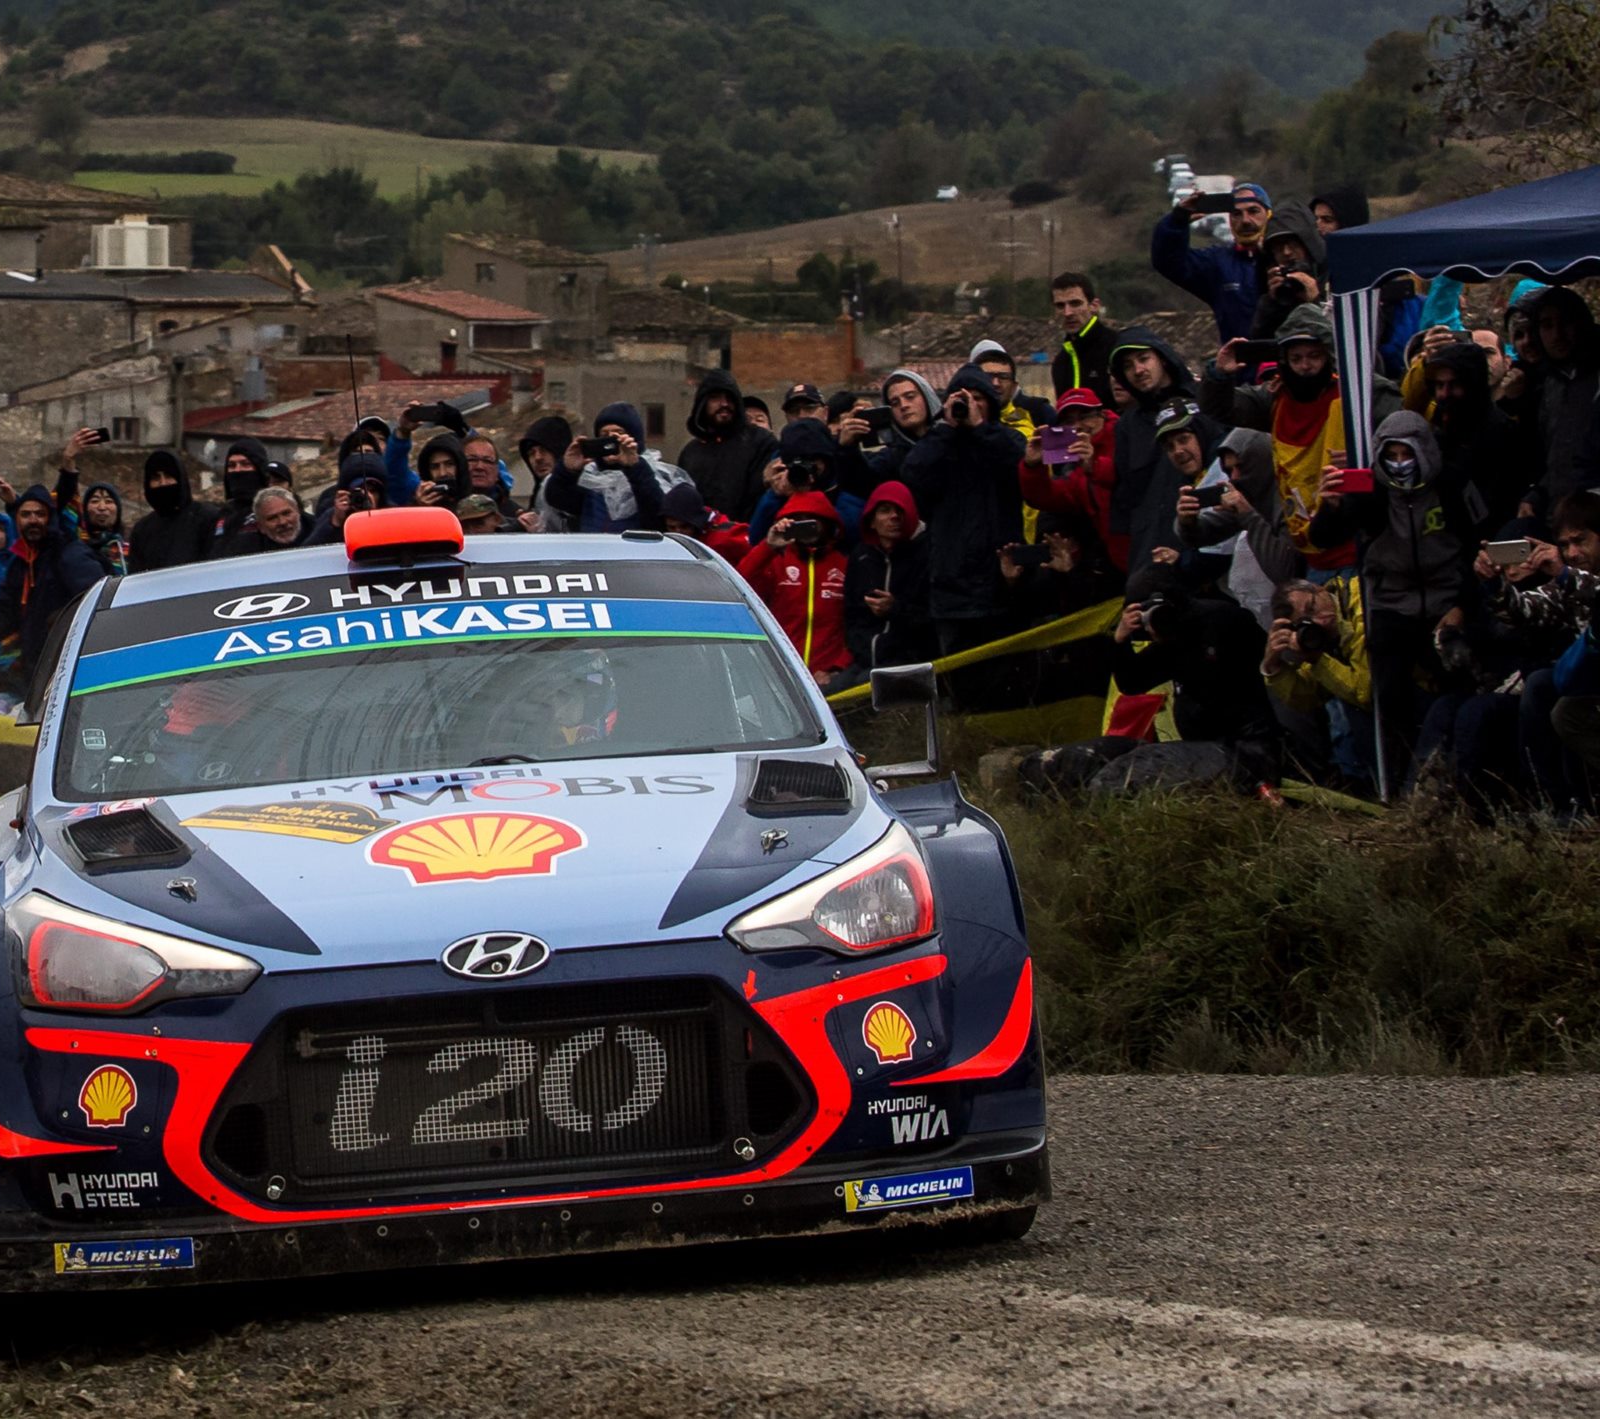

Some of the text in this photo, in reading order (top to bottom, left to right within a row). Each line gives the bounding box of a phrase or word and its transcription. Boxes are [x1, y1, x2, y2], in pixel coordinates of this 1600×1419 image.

[329, 573, 609, 607] HYUNDAI
[291, 767, 542, 799] HYUNDAI
[377, 774, 715, 811] MOBIS
[330, 1025, 667, 1151] i20
[867, 1095, 928, 1115] HYUNDAI
[81, 1172, 159, 1189] HYUNDAI
[885, 1177, 964, 1198] MICHELIN
[85, 1192, 140, 1208] STEEL
[90, 1248, 181, 1263] MICHELIN
